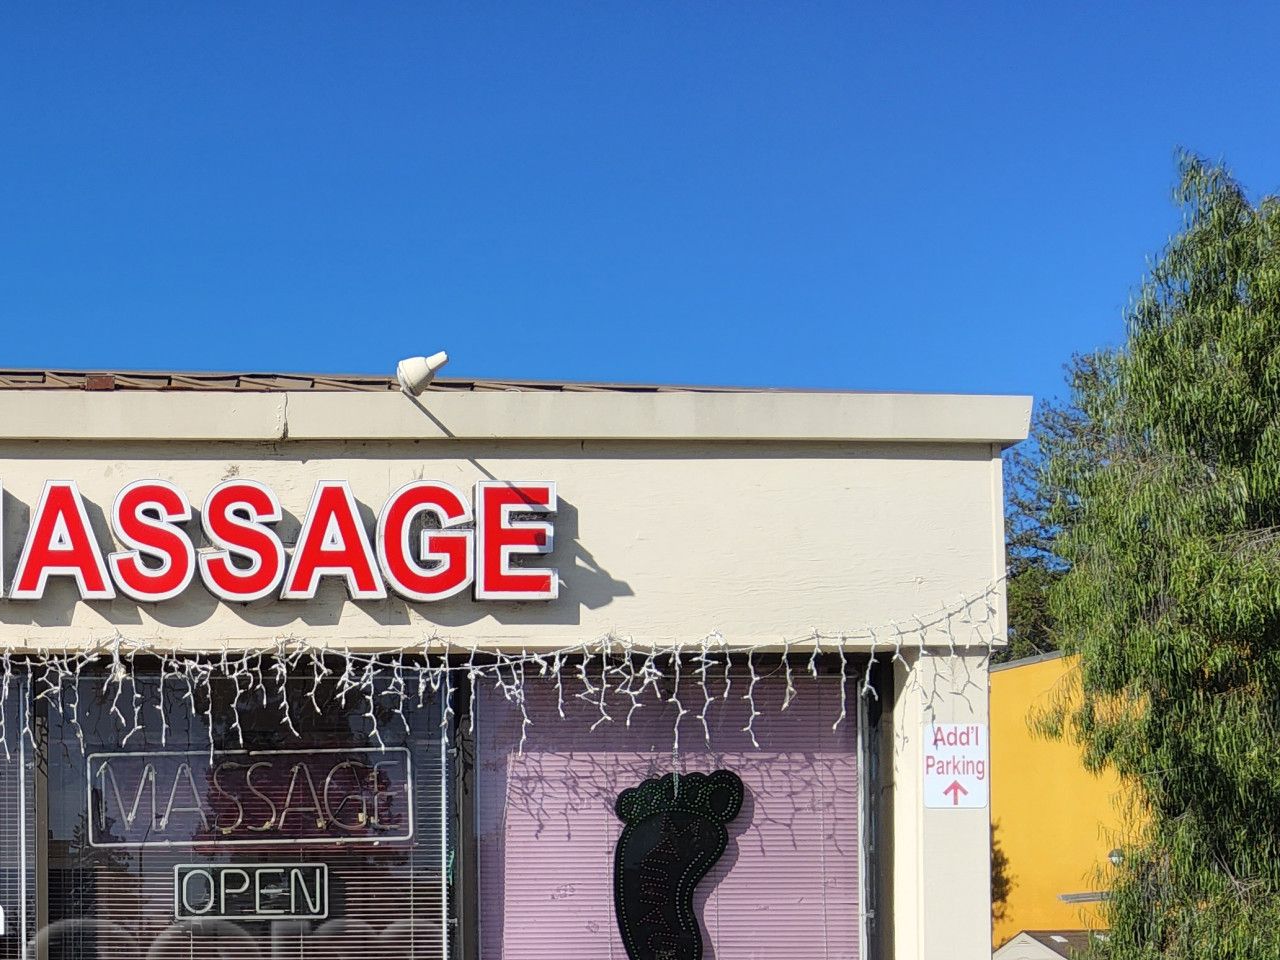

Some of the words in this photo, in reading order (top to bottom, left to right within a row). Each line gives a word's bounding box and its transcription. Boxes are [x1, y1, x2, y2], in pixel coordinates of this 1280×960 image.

[932, 726, 979, 746] Add'l
[925, 755, 985, 780] Parking
[96, 759, 401, 834] MASSAGE
[181, 867, 321, 915] OPEN
